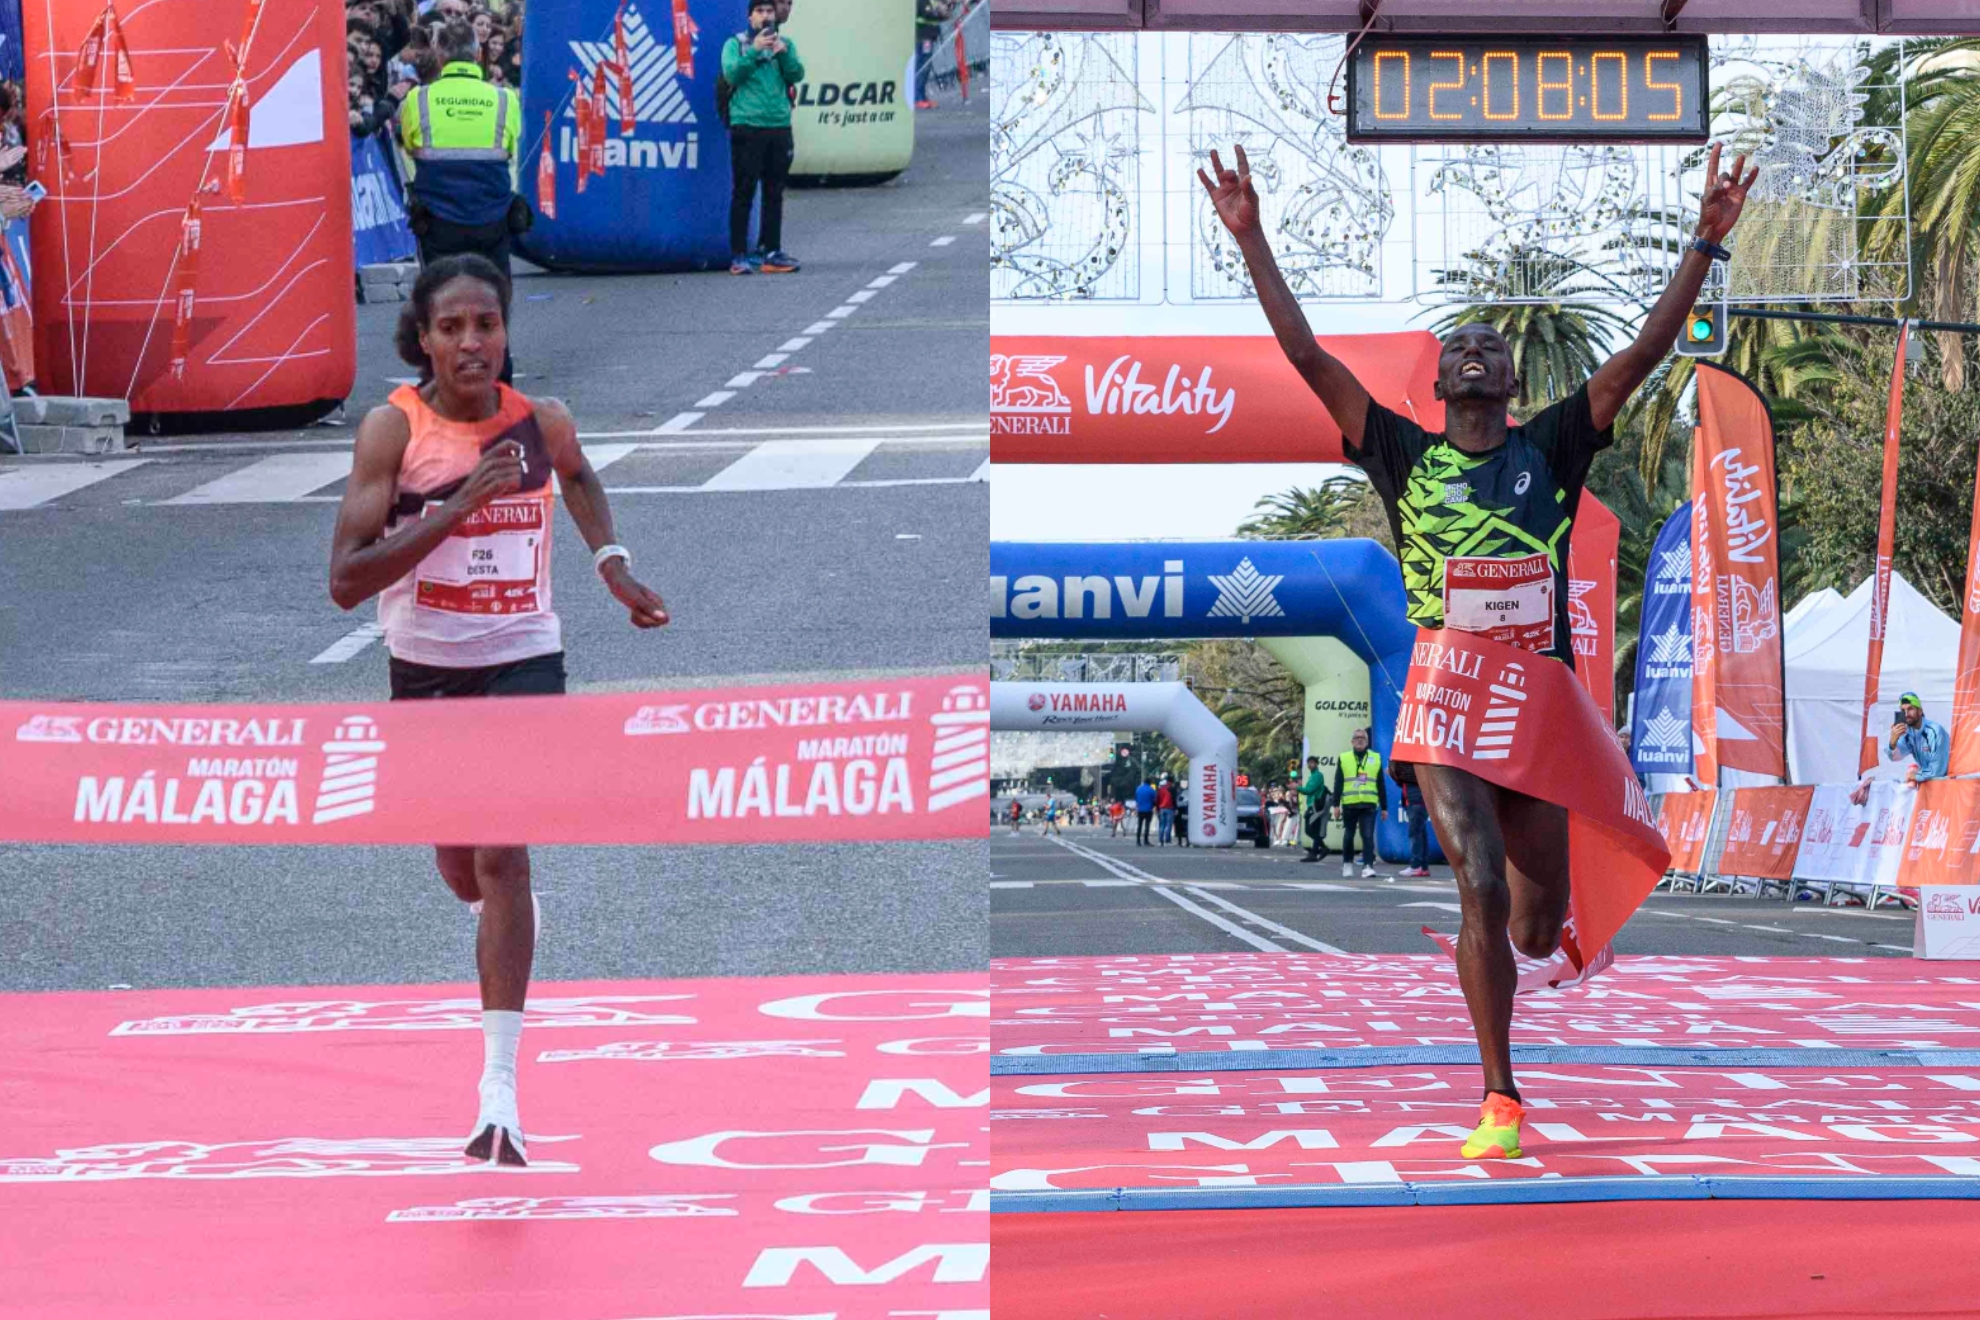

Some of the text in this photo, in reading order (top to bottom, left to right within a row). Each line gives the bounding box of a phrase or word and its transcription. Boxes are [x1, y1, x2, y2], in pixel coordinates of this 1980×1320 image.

[435, 97, 494, 107] SEGURIDAD
[797, 81, 896, 106] LDCAR
[818, 111, 840, 124] It's
[842, 111, 867, 127] just
[880, 111, 896, 122] car
[1085, 355, 1235, 434] Vitality
[466, 506, 539, 524] ENERALI
[472, 550, 493, 560] F26
[467, 566, 499, 575] DESTA
[1477, 559, 1544, 578] GENERALI
[1485, 601, 1519, 611] KIGEN
[1050, 693, 1127, 711] YAMAHA
[1315, 700, 1369, 711] GOLDCAR
[693, 692, 914, 732] GENERALI
[87, 718, 308, 746] GENERALI
[798, 732, 908, 760] MARATÓN
[1637, 749, 1690, 763] luanvi
[188, 756, 298, 778] MARATÓN
[687, 756, 914, 819] MÁLAGA
[1203, 763, 1217, 821] YAMAHA
[73, 770, 300, 825] MÁLAGA
